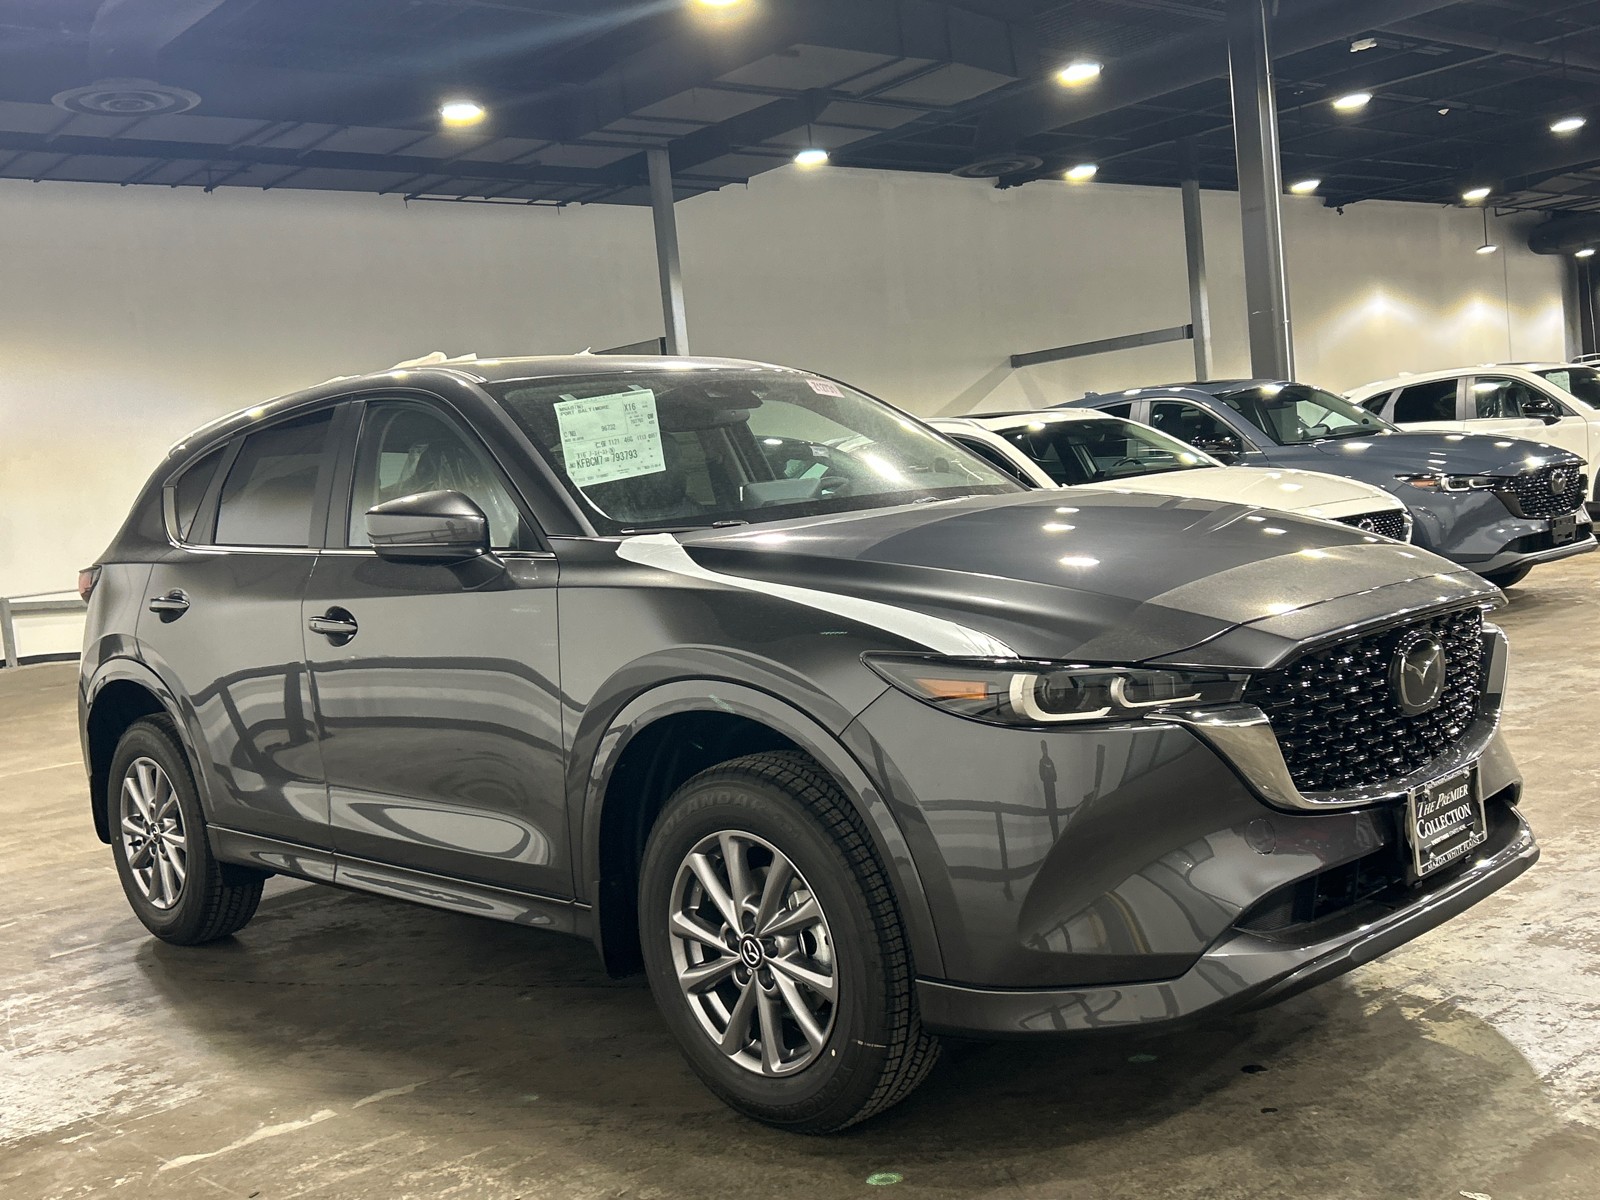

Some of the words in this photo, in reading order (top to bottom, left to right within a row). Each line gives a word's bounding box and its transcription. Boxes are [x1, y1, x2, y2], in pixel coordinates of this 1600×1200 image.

[578, 405, 609, 413] BALTIMORE
[624, 403, 636, 411] X16
[576, 456, 603, 469] KFBCM7
[611, 449, 638, 462] 793793
[1417, 800, 1437, 819] THE
[1435, 784, 1469, 810] PREMIER
[1416, 802, 1472, 839] COLLECTION
[1427, 855, 1446, 871] MAZDA
